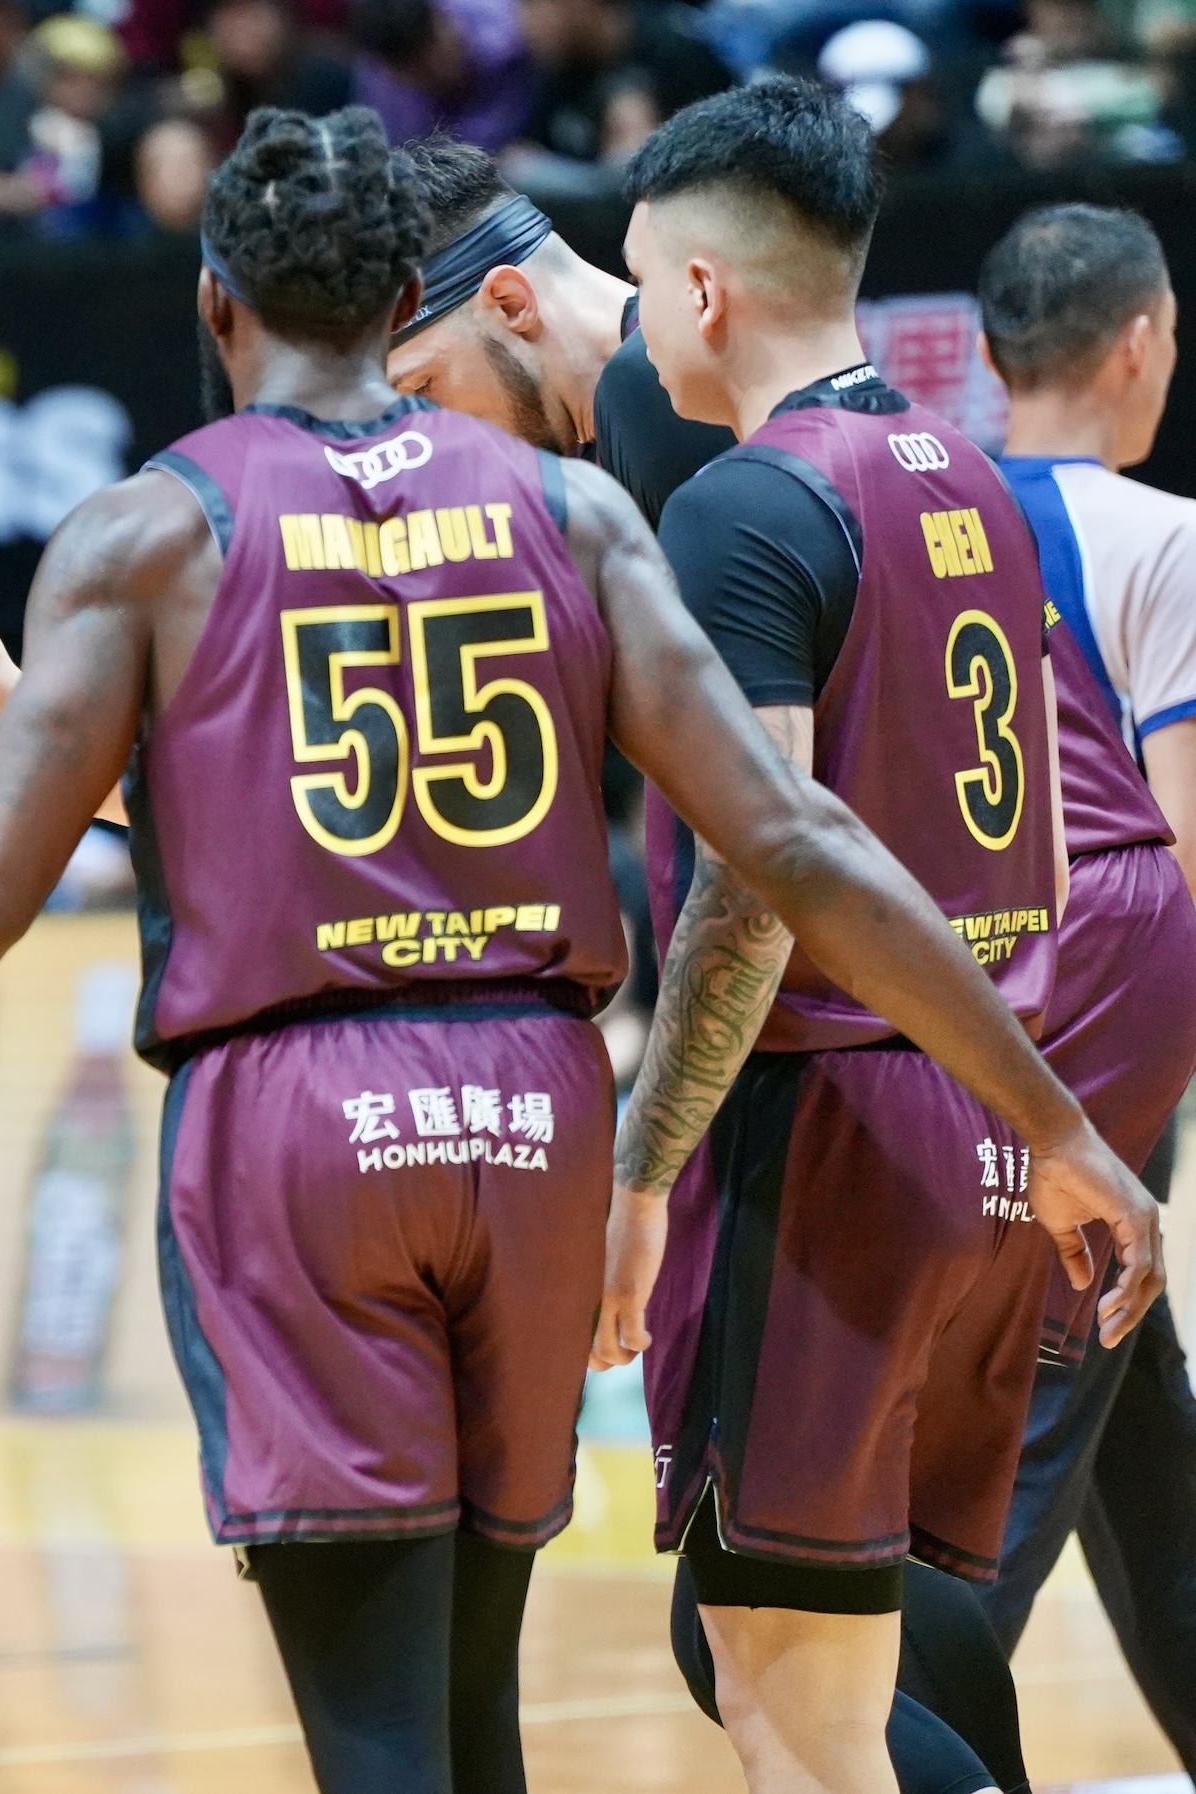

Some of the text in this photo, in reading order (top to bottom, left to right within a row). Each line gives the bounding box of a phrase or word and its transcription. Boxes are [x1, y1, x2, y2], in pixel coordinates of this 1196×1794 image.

[920, 507, 994, 579] CHEN
[280, 590, 558, 857] 55
[944, 610, 1025, 851] 3
[316, 905, 561, 951] NEW TAIPEI
[948, 908, 1049, 941] EW TAIPEI
[971, 936, 1018, 965] CITY
[381, 935, 489, 968] CITY
[341, 1083, 554, 1144] 宏匯廣場
